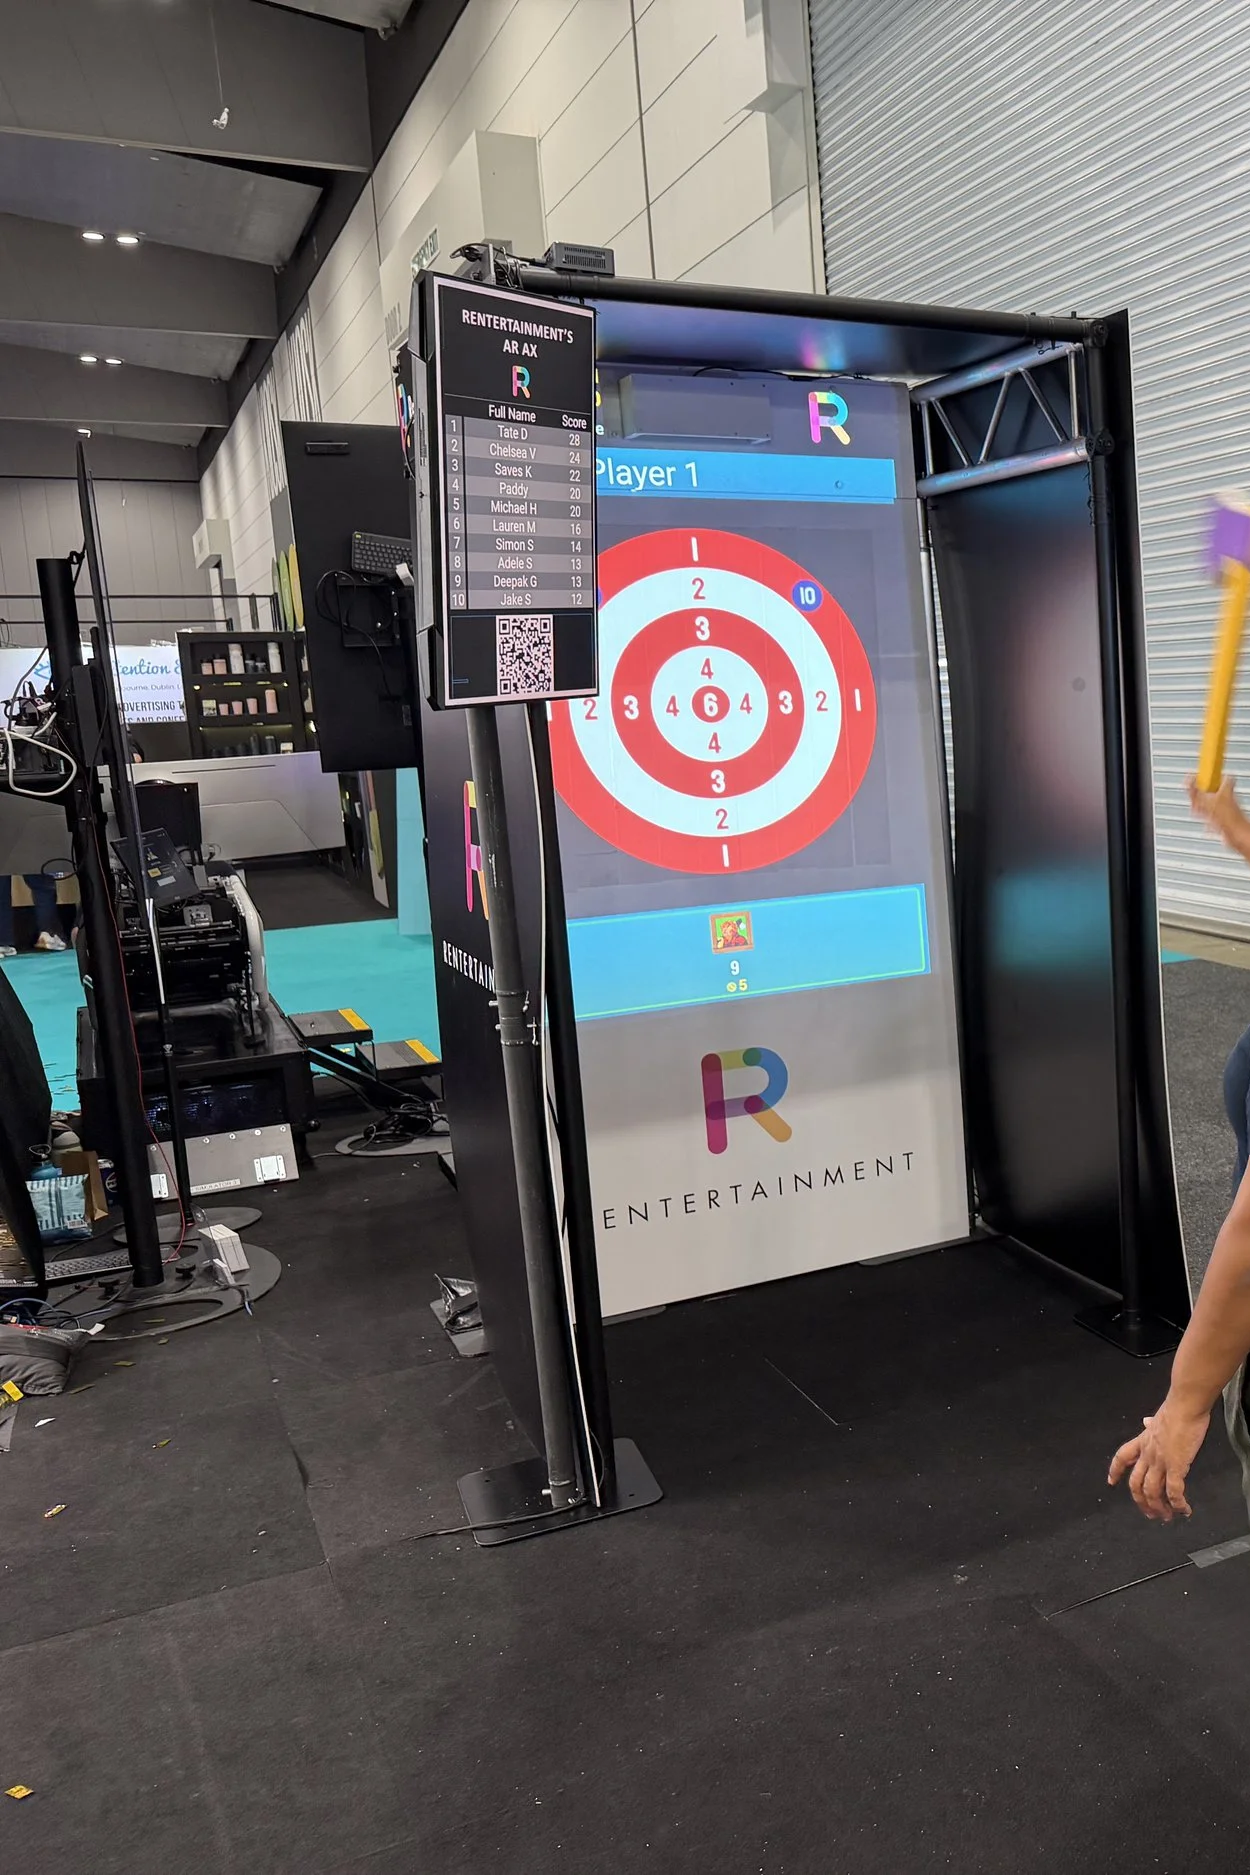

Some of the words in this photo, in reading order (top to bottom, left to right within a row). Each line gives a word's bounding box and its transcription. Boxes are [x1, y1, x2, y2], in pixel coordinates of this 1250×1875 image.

[462, 309, 574, 344] RENTERTAINMENT'S
[503, 339, 519, 355] AR
[522, 342, 538, 359] AX
[488, 404, 506, 419] Full
[508, 407, 536, 422] Name
[562, 414, 587, 430] Score
[808, 391, 851, 445] R
[451, 420, 457, 432] 1
[498, 424, 519, 438] Tate
[521, 427, 528, 439] D
[569, 434, 580, 446] 28
[451, 439, 458, 452] 2
[490, 443, 527, 458] Chelsea
[529, 447, 536, 459] V
[569, 452, 580, 464] 24
[452, 458, 459, 471] 3
[495, 463, 522, 477] Saves
[524, 466, 532, 478] K
[569, 470, 580, 482] 22
[685, 461, 698, 487] 1
[452, 480, 459, 491] 4
[499, 482, 529, 498] Paddy
[569, 488, 581, 500] 20
[453, 498, 460, 510] 5
[491, 500, 527, 514] Michael
[529, 503, 537, 515] H
[570, 505, 581, 518] 20
[453, 518, 460, 530] 6
[493, 519, 524, 532] Lauren
[527, 521, 536, 533] M
[570, 523, 581, 535] 16
[454, 537, 460, 549] 7
[495, 538, 525, 551] Simon
[527, 540, 534, 551] S
[570, 541, 581, 553] 14
[454, 556, 461, 568] 8
[497, 556, 524, 569] Adele
[526, 558, 533, 569] S
[571, 559, 582, 570] 13
[454, 575, 461, 587] 9
[493, 575, 528, 589] Deepak
[530, 576, 537, 588] G
[571, 576, 582, 587] 13
[692, 577, 706, 600] 2
[453, 594, 464, 606] 10
[500, 594, 522, 606] Jake
[524, 594, 531, 605] S
[571, 594, 582, 605] 12
[799, 586, 816, 604] 10
[695, 615, 711, 641] 3
[120, 658, 171, 676] ention
[700, 658, 714, 679] 4
[583, 698, 598, 720] 2
[624, 696, 640, 720] 3
[665, 696, 679, 717] 4
[703, 693, 719, 717] 6
[739, 693, 752, 714] 4
[779, 690, 793, 715] 3
[815, 690, 828, 712] 2
[708, 732, 722, 754] 4
[710, 769, 726, 794] 3
[715, 808, 729, 830] 2
[443, 940, 495, 993] RENTERTAIN
[730, 960, 741, 976] 9
[738, 978, 748, 991] 5
[701, 1047, 792, 1155] R
[603, 1151, 915, 1230] ENTERTAINMENT
